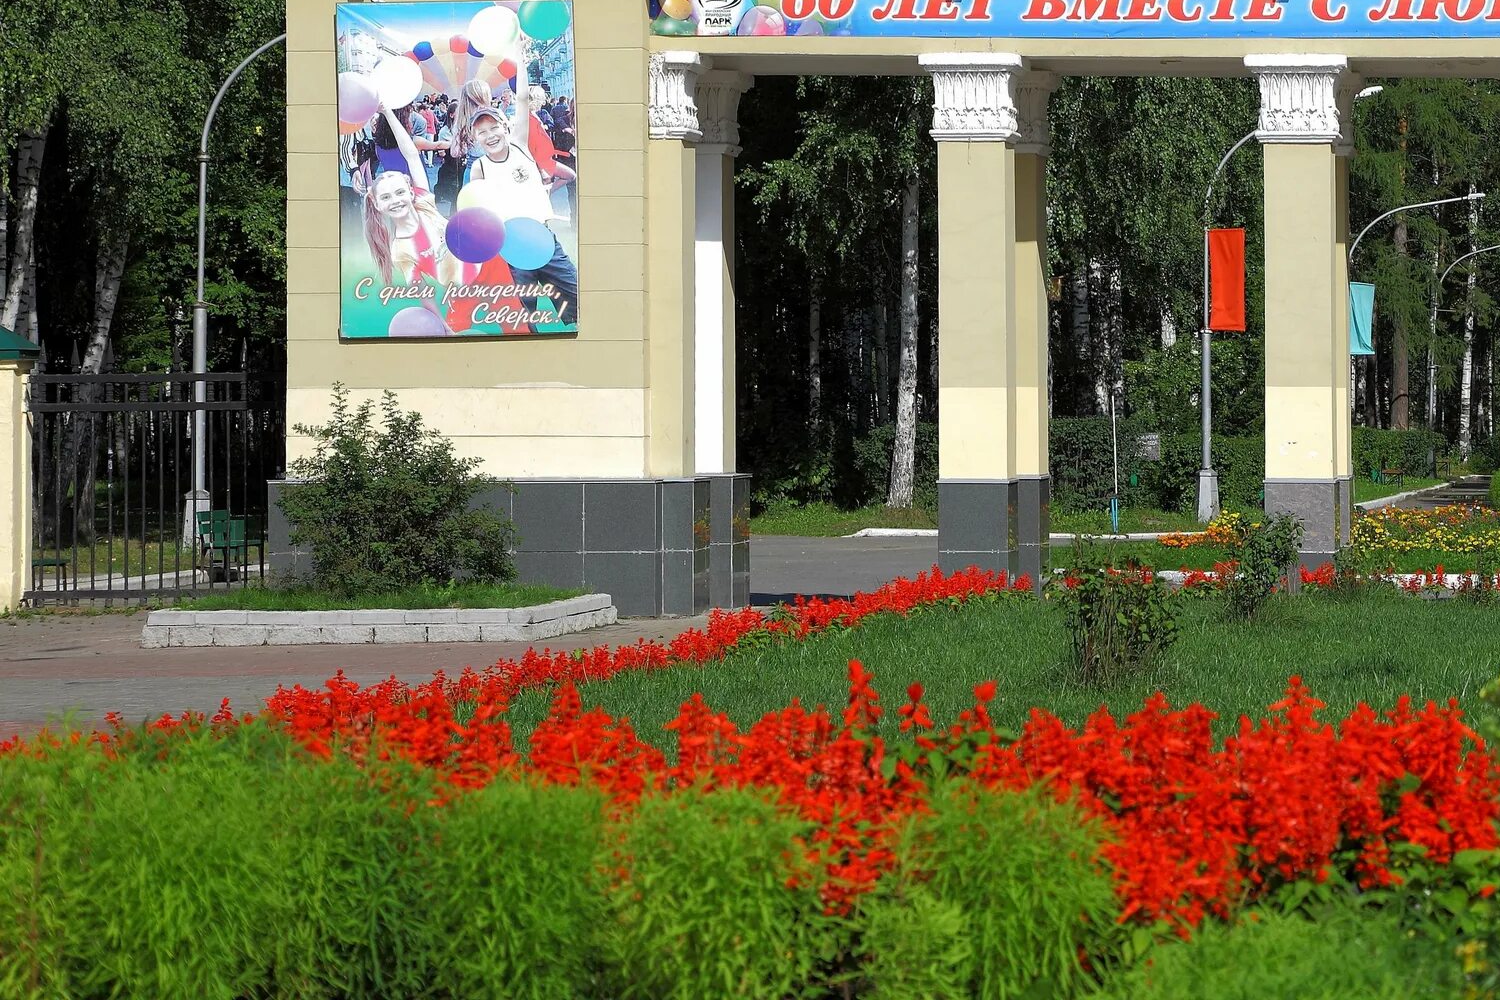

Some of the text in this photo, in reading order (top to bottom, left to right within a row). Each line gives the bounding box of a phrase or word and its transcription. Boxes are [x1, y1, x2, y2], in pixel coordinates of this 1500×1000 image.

[705, 17, 732, 25] ПАРК
[355, 277, 561, 306] С днём рождения,
[471, 301, 568, 329] Северск!
